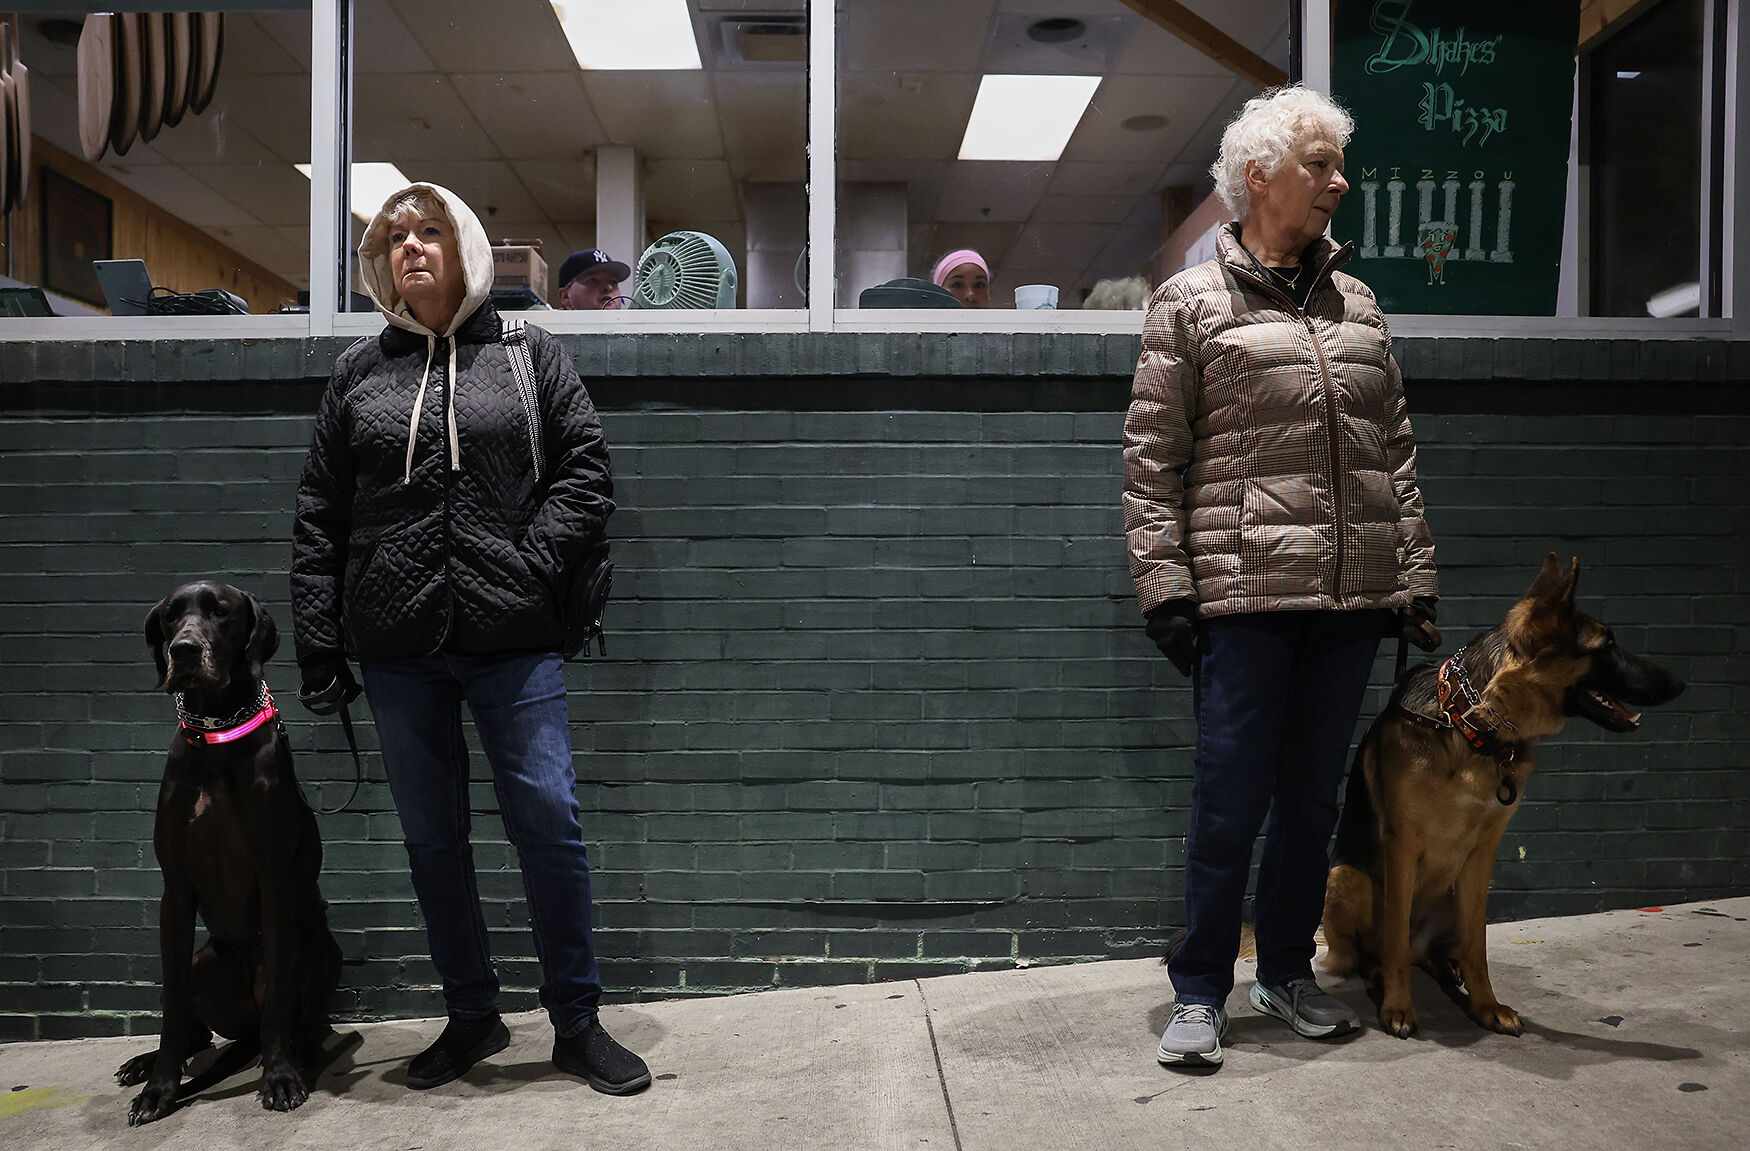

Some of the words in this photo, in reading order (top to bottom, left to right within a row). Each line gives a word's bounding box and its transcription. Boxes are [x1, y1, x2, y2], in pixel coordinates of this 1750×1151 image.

[1417, 81, 1508, 148] Pizza
[1361, 166, 1513, 181] MIZZOU
[593, 250, 608, 263] NY
